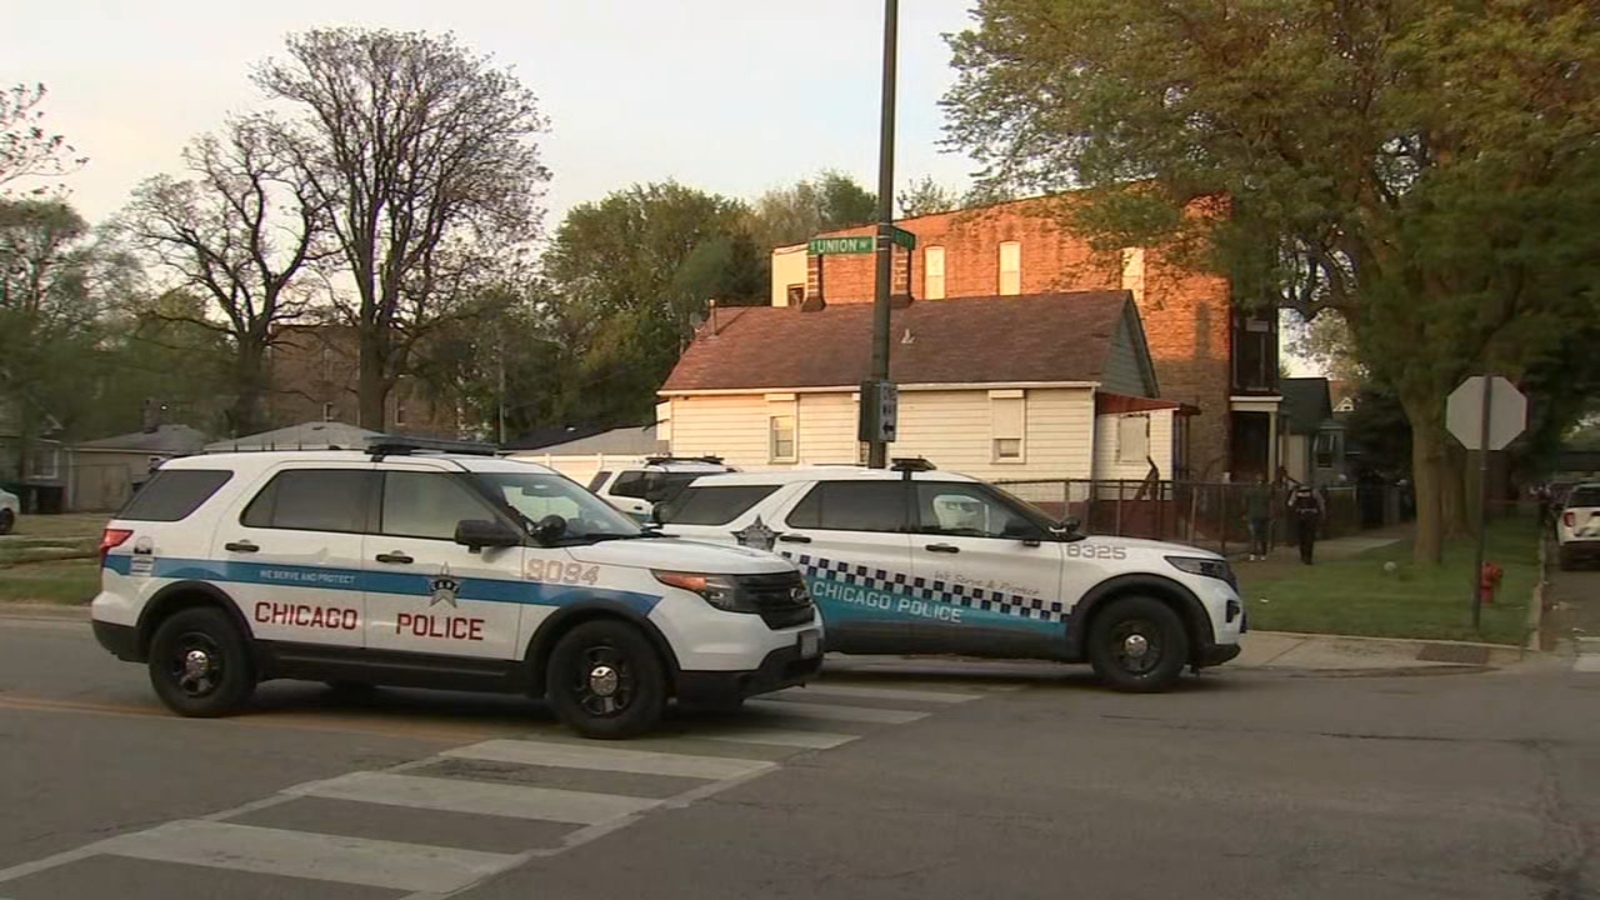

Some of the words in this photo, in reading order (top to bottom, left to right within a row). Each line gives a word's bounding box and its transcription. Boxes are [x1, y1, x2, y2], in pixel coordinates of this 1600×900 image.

[817, 239, 858, 252] UNION
[1066, 543, 1127, 560] 8325
[274, 570, 300, 580] SERVE
[319, 573, 356, 584] PROTECT
[525, 558, 601, 585] 9094
[812, 581, 892, 610] CHICAGO
[897, 598, 965, 623] POLICE
[254, 601, 358, 630] CHICAGO
[396, 612, 486, 641] POLICE
